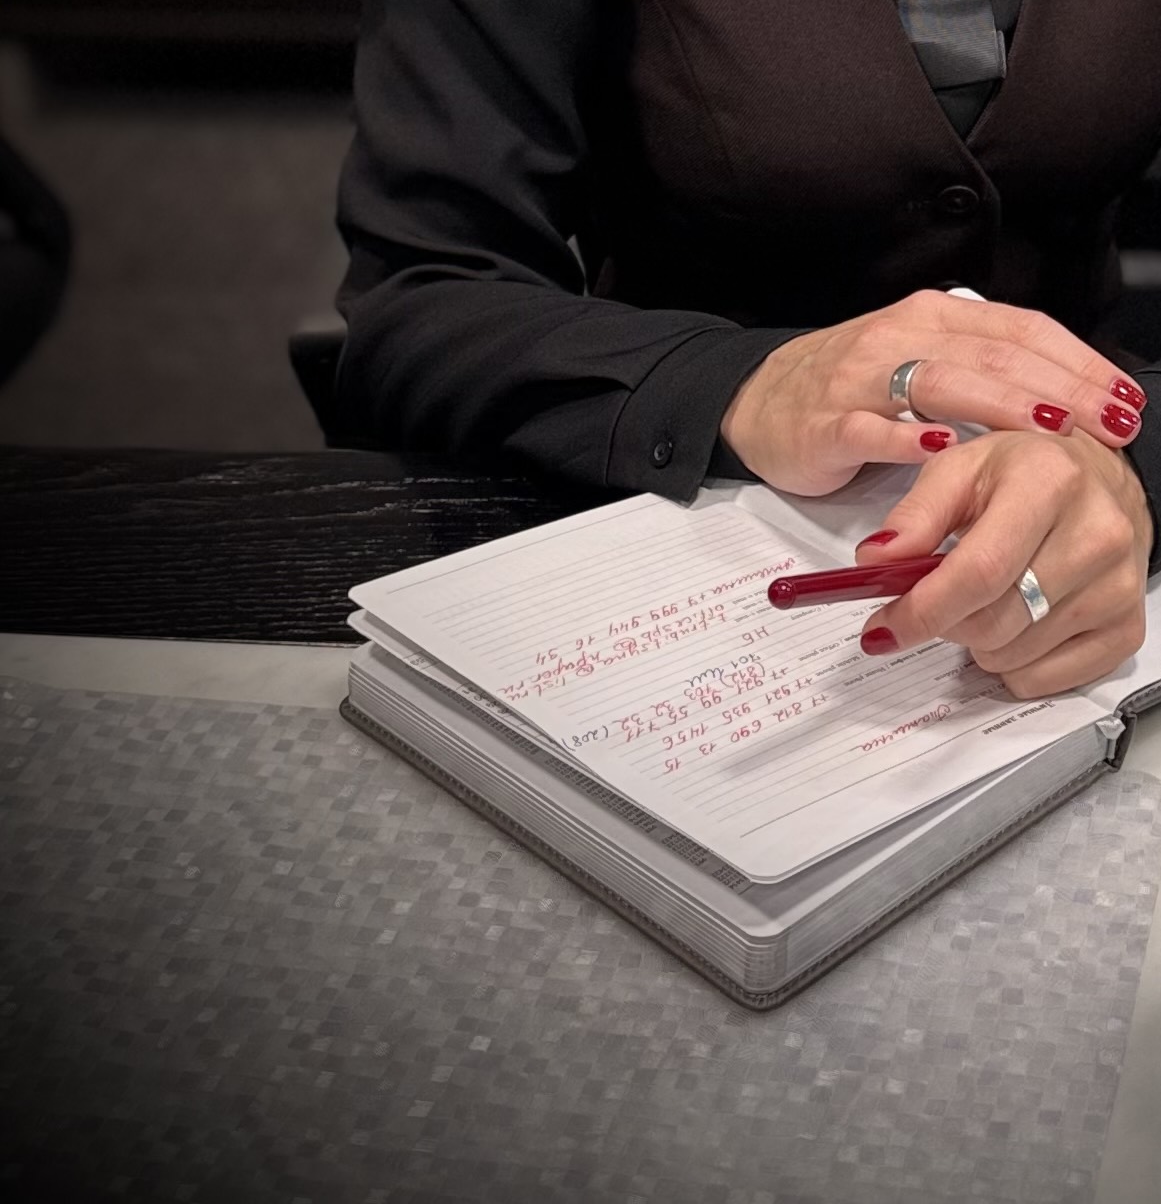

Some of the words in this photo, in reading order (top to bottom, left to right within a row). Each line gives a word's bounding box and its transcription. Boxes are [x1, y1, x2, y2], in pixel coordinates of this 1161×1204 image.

[649, 603, 678, 621] 999
[609, 616, 640, 637] 944
[765, 684, 791, 705] 921
[723, 703, 752, 722] 935
[771, 702, 802, 722] 812
[728, 720, 761, 743] 690
